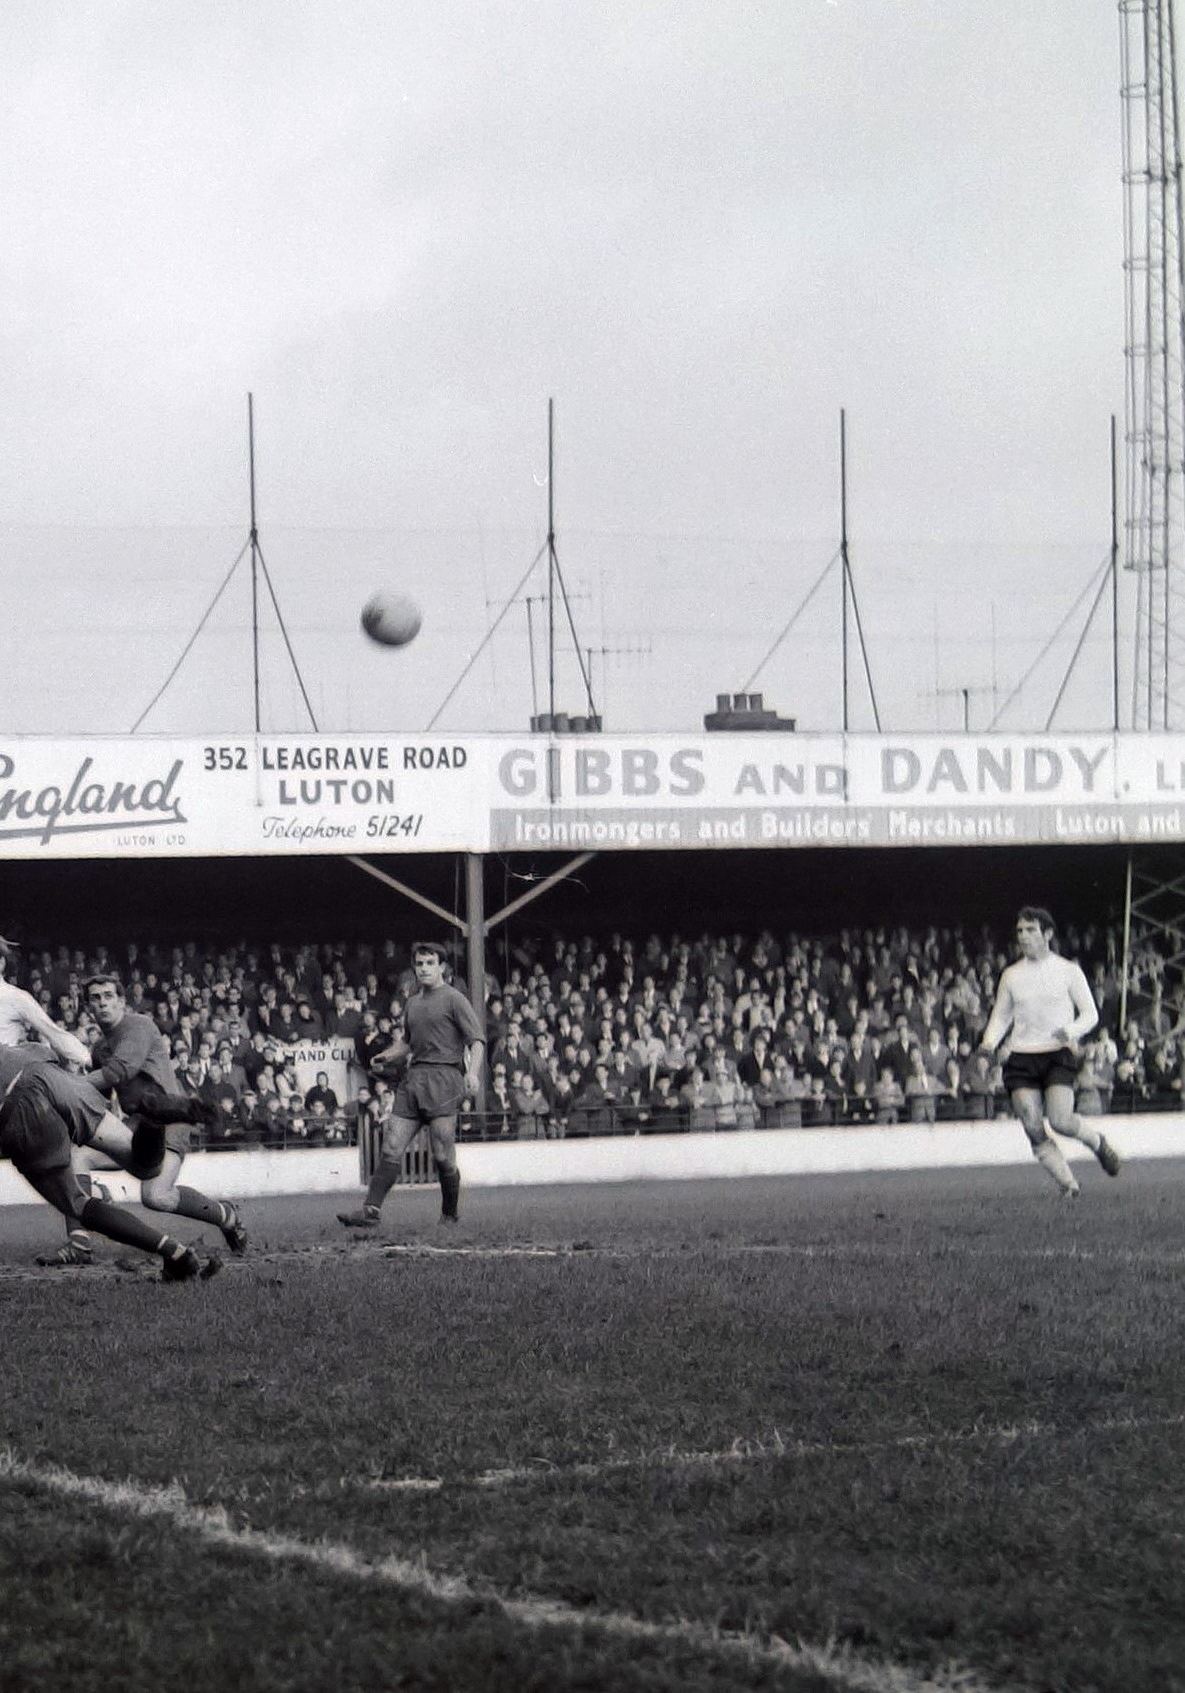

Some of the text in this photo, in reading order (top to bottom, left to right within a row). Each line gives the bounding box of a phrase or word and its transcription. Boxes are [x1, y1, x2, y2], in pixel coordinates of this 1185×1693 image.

[204, 746, 467, 770] 352 LEAGRAVE ROAD
[498, 748, 706, 797] GIBBS
[734, 763, 848, 796] AND
[279, 779, 395, 805] LUTON
[262, 814, 423, 844] Telephone 51241
[515, 813, 681, 846] Ironmongers
[699, 814, 746, 839] and
[762, 811, 870, 839] Builders
[889, 810, 1015, 838] Merchants
